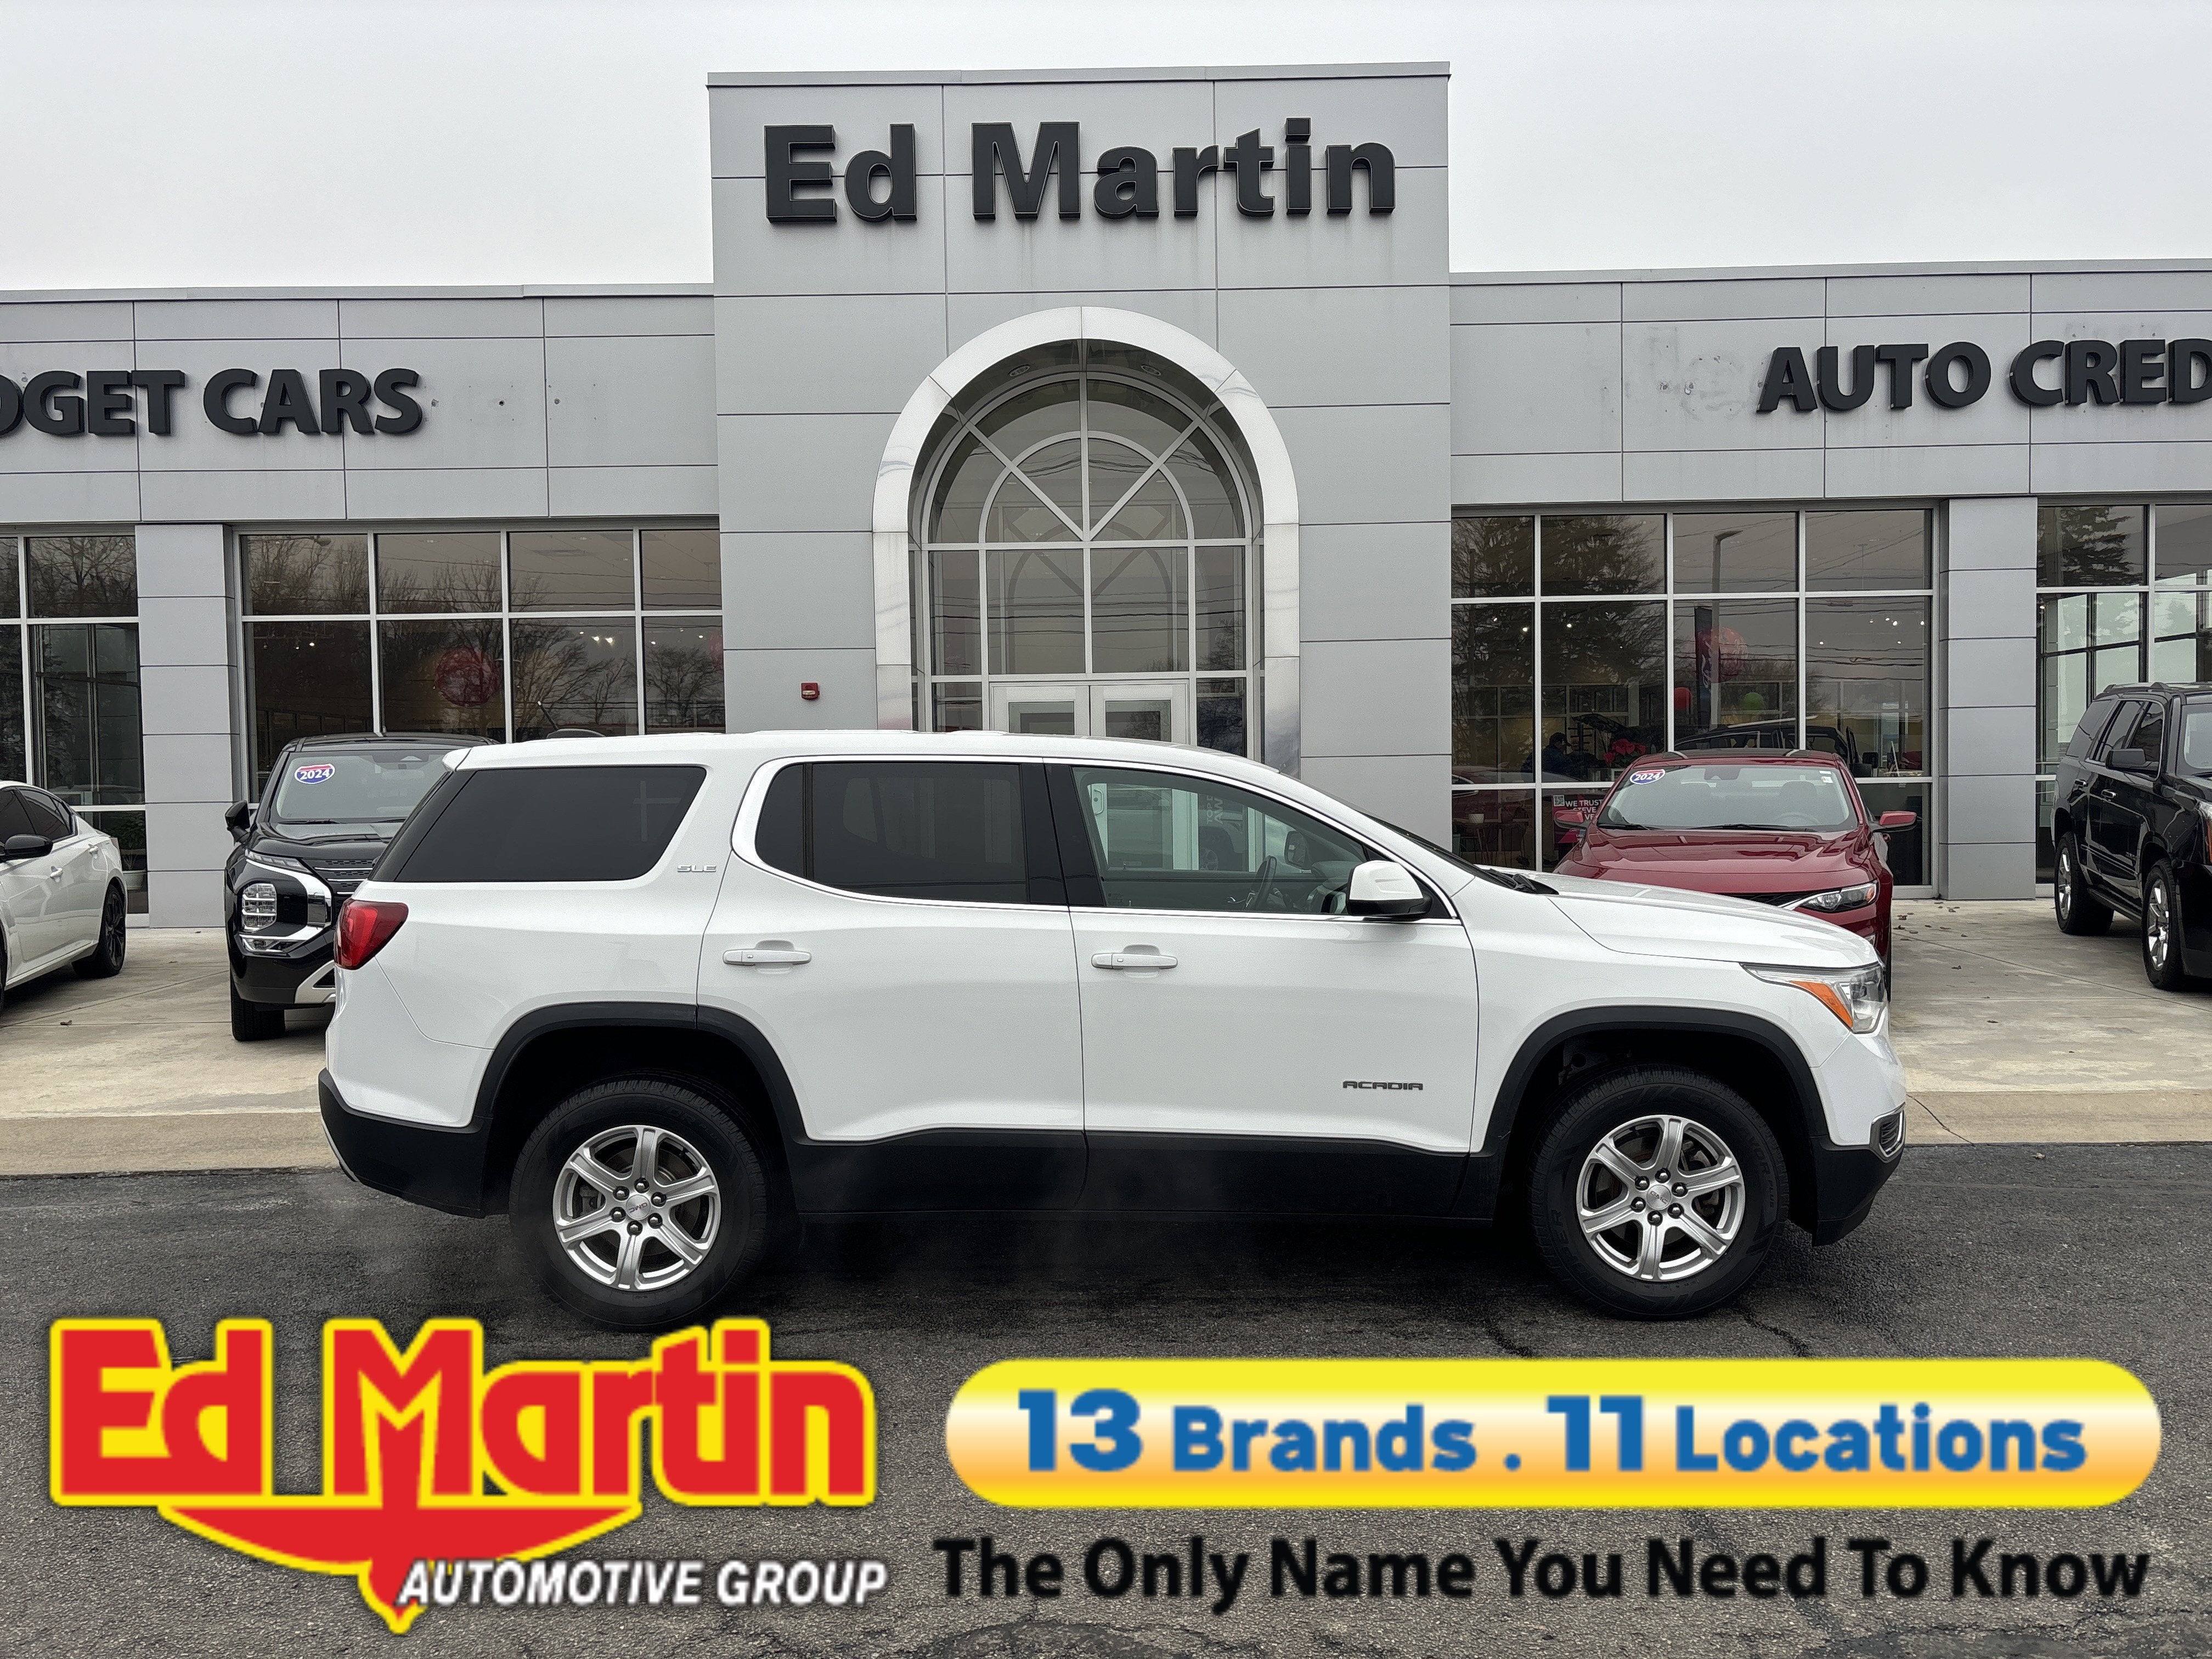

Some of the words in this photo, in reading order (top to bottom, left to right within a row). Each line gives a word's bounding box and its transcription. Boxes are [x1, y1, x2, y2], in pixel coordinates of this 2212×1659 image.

[764, 123, 917, 223] Ed
[972, 117, 1396, 219] Martin
[1757, 341, 1992, 412] AUTO
[2009, 338, 2212, 406] CRED
[202, 368, 423, 436] CARS
[300, 769, 330, 780] 2024
[1633, 772, 1661, 781] 2024
[677, 865, 716, 873] SLE
[1342, 1080, 1424, 1091] ACADIA
[1650, 1190, 1668, 1205] GMC
[628, 1202, 647, 1213] GMC
